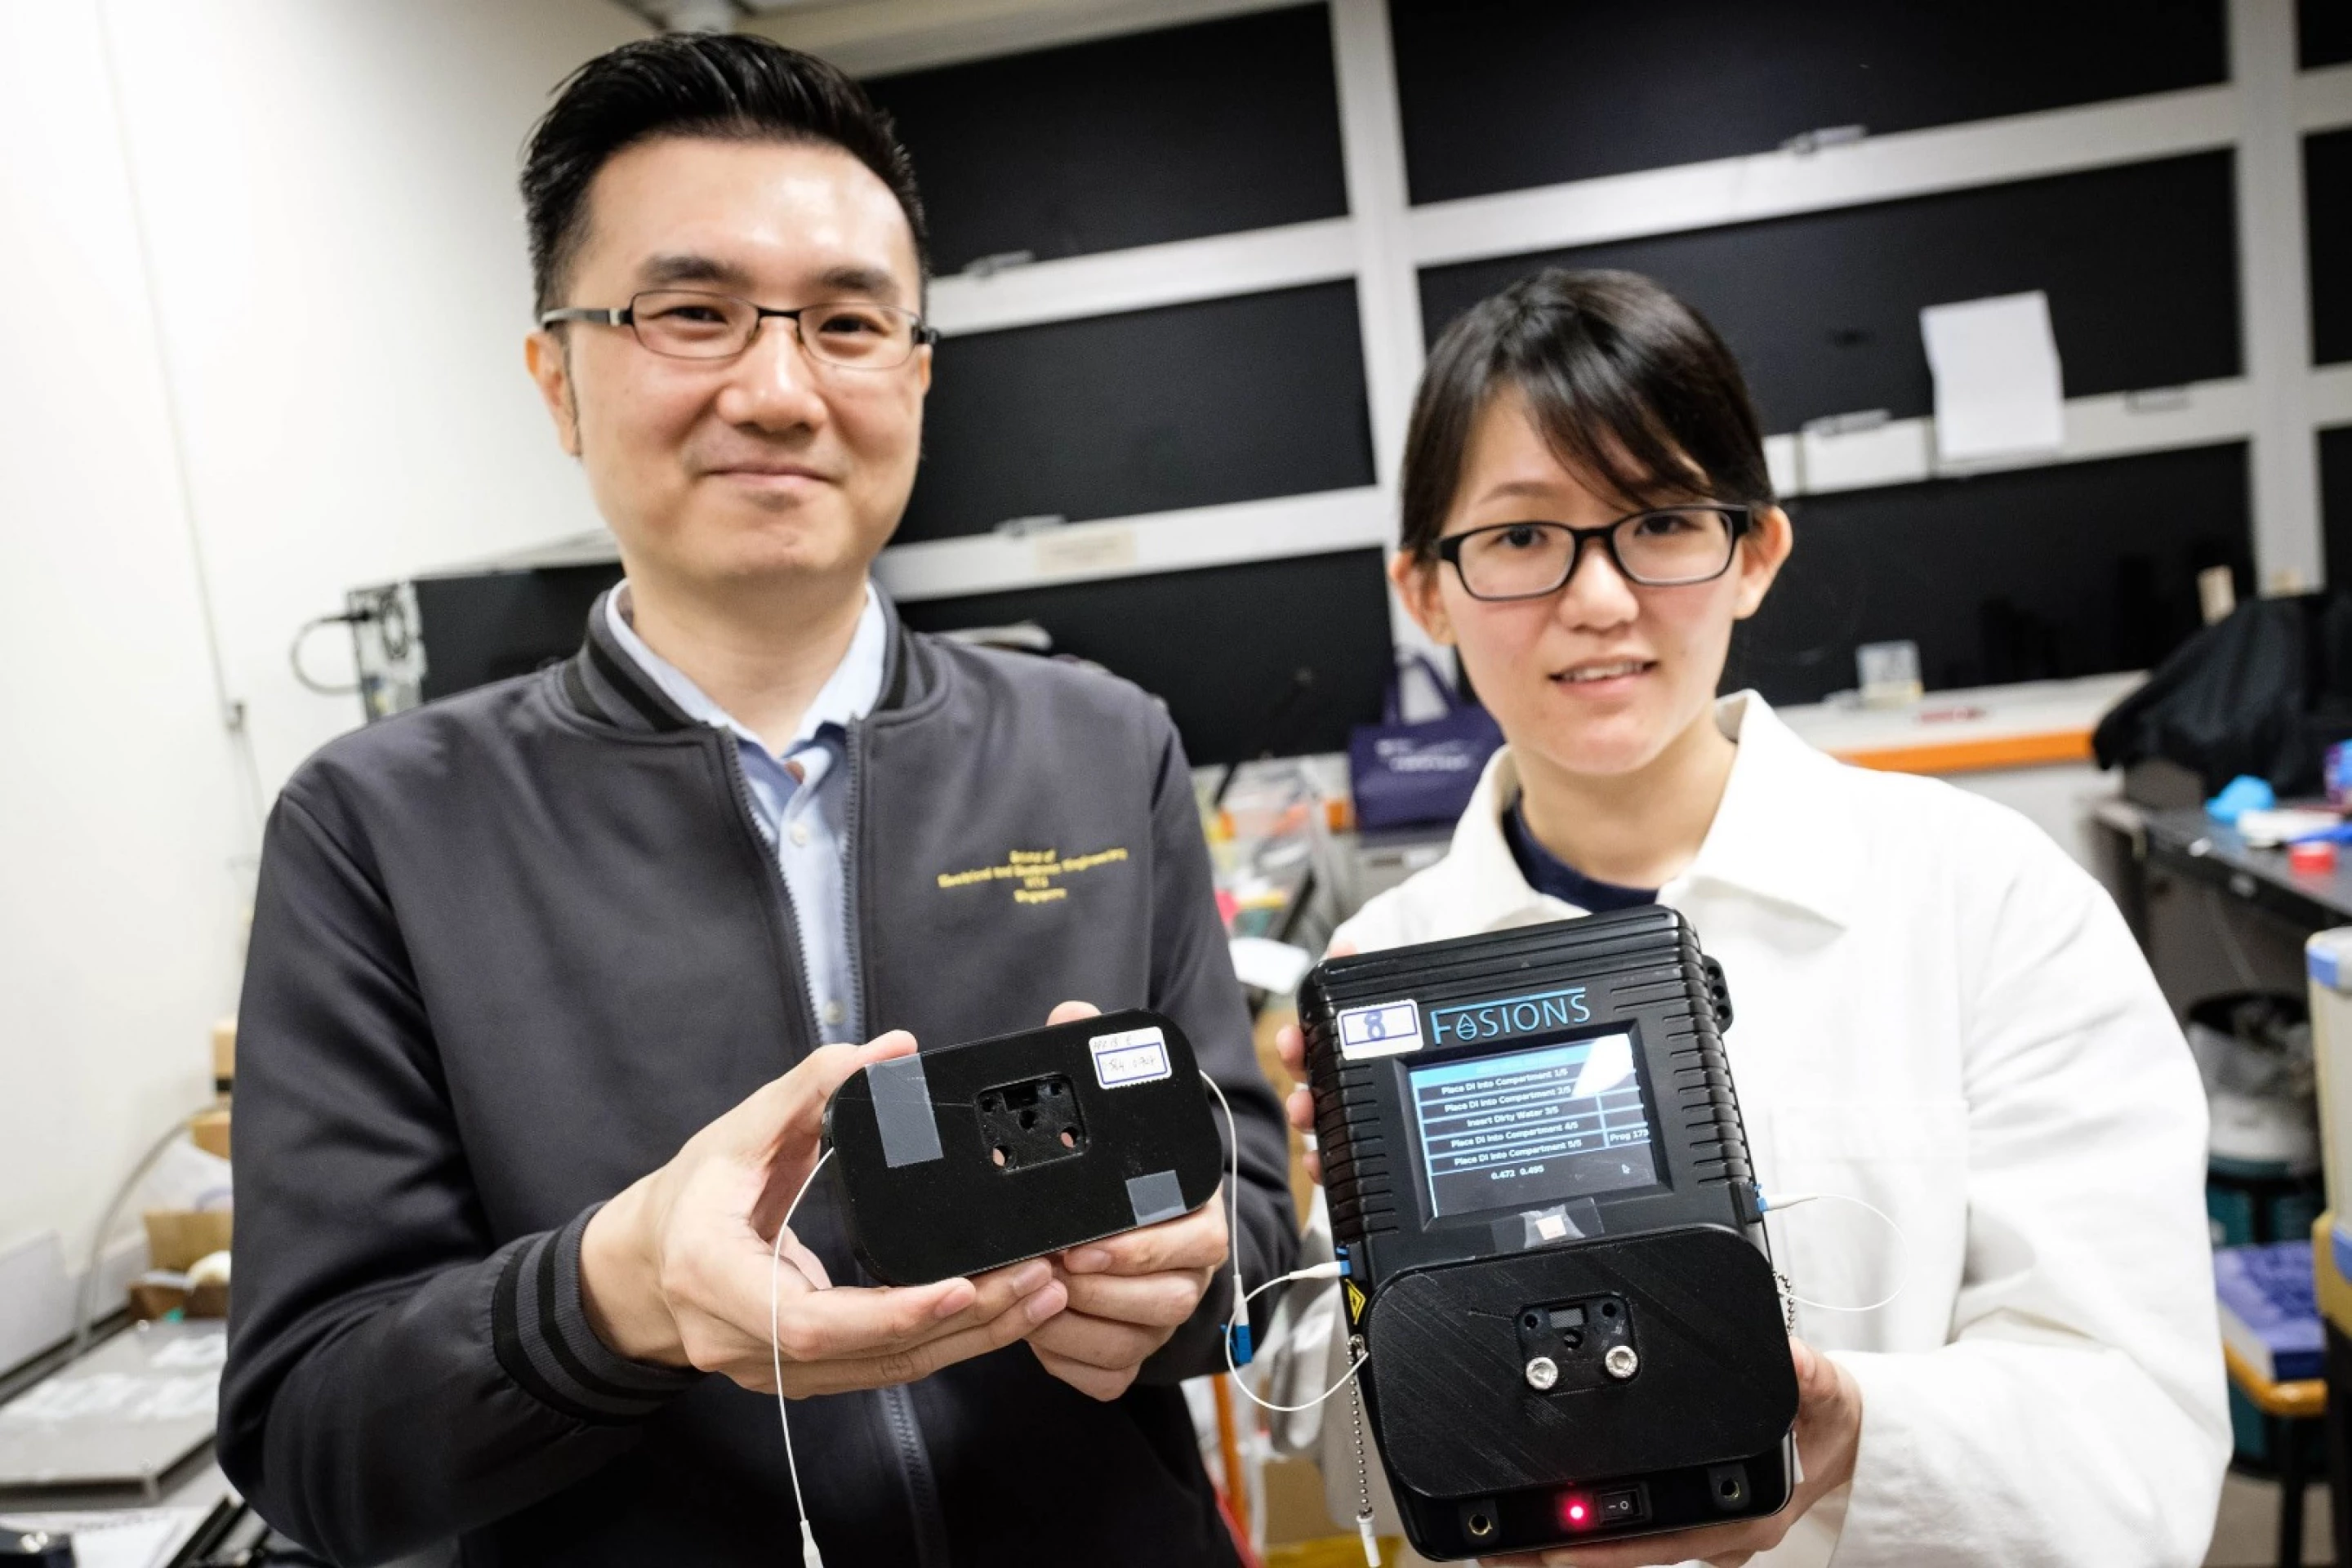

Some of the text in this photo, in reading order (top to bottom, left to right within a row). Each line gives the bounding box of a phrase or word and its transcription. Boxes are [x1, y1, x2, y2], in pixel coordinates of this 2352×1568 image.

[1364, 1009, 1386, 1040] 8
[1441, 1086, 1464, 1095] Place
[1495, 1071, 1552, 1085] Compartment
[1445, 1104, 1468, 1113] Place
[1499, 1089, 1555, 1103] Compartment
[1467, 1117, 1493, 1128] Insert
[1494, 1113, 1515, 1124] Dirty
[1516, 1110, 1544, 1120] Water
[1451, 1139, 1474, 1148] Place
[1506, 1124, 1562, 1138] Compartment
[1454, 1157, 1477, 1166] Place
[1509, 1142, 1566, 1156] Compartment
